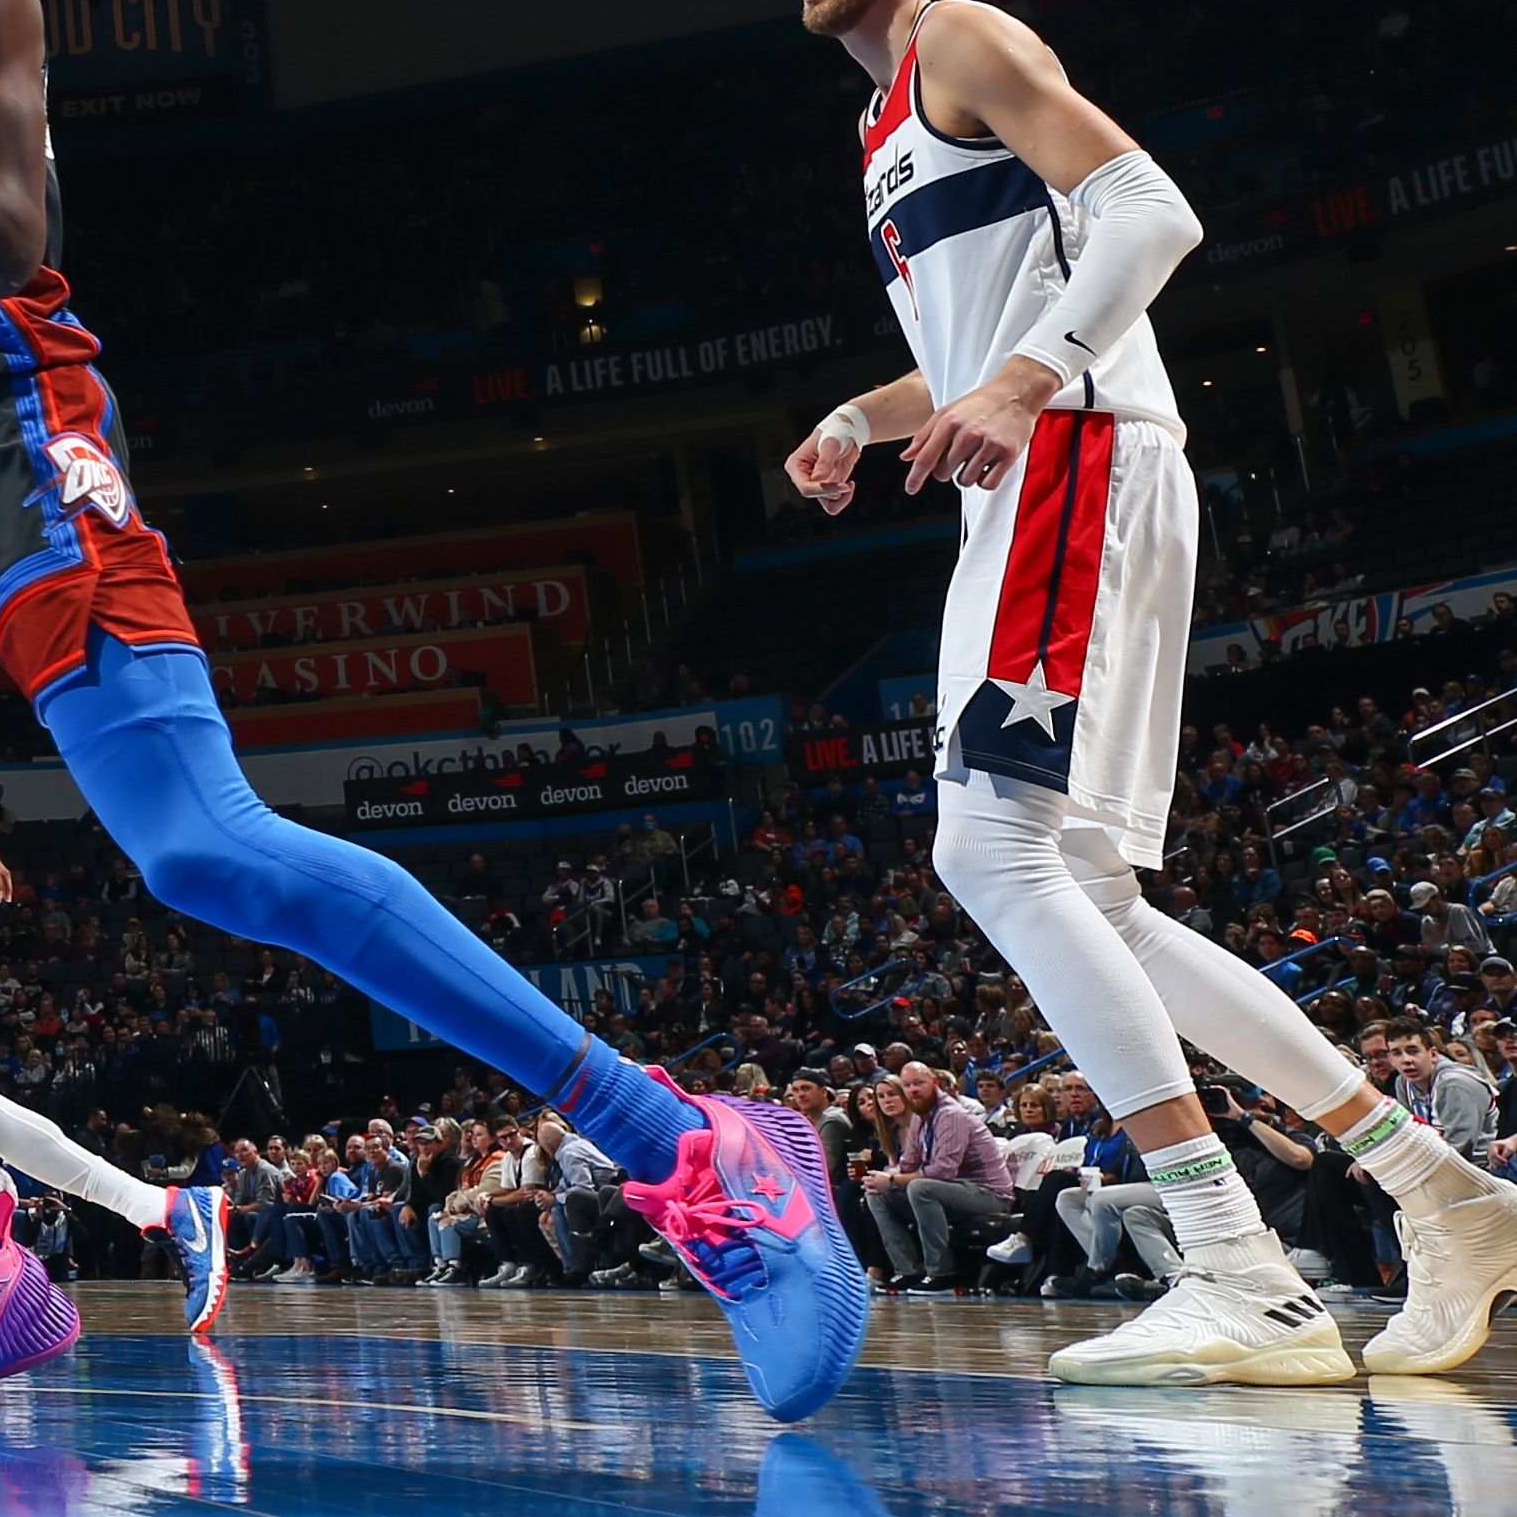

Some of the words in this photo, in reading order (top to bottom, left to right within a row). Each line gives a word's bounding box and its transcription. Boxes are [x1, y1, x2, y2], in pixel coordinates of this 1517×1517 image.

[242, 22, 260, 84] 303
[61, 95, 127, 118] EXIT
[136, 88, 201, 111] NOW
[1206, 233, 1284, 265] devon
[1314, 186, 1383, 236] LIVE.
[1388, 176, 1410, 216] A
[1413, 155, 1472, 206] LIFE
[367, 395, 435, 420] devon
[471, 368, 540, 408] LIVE.
[546, 364, 565, 398] A
[569, 352, 625, 393] LIFE
[630, 341, 695, 385] FULL
[698, 334, 730, 376] OF
[735, 315, 844, 367] ENERGY.
[1397, 310, 1422, 381] 205
[721, 717, 777, 755] 102
[805, 736, 859, 771] LIVE.
[862, 734, 876, 765] A
[880, 728, 926, 762] LIFE
[356, 800, 424, 821] devon
[447, 791, 517, 813] devon
[540, 782, 603, 805] devon
[624, 771, 689, 797] devon
